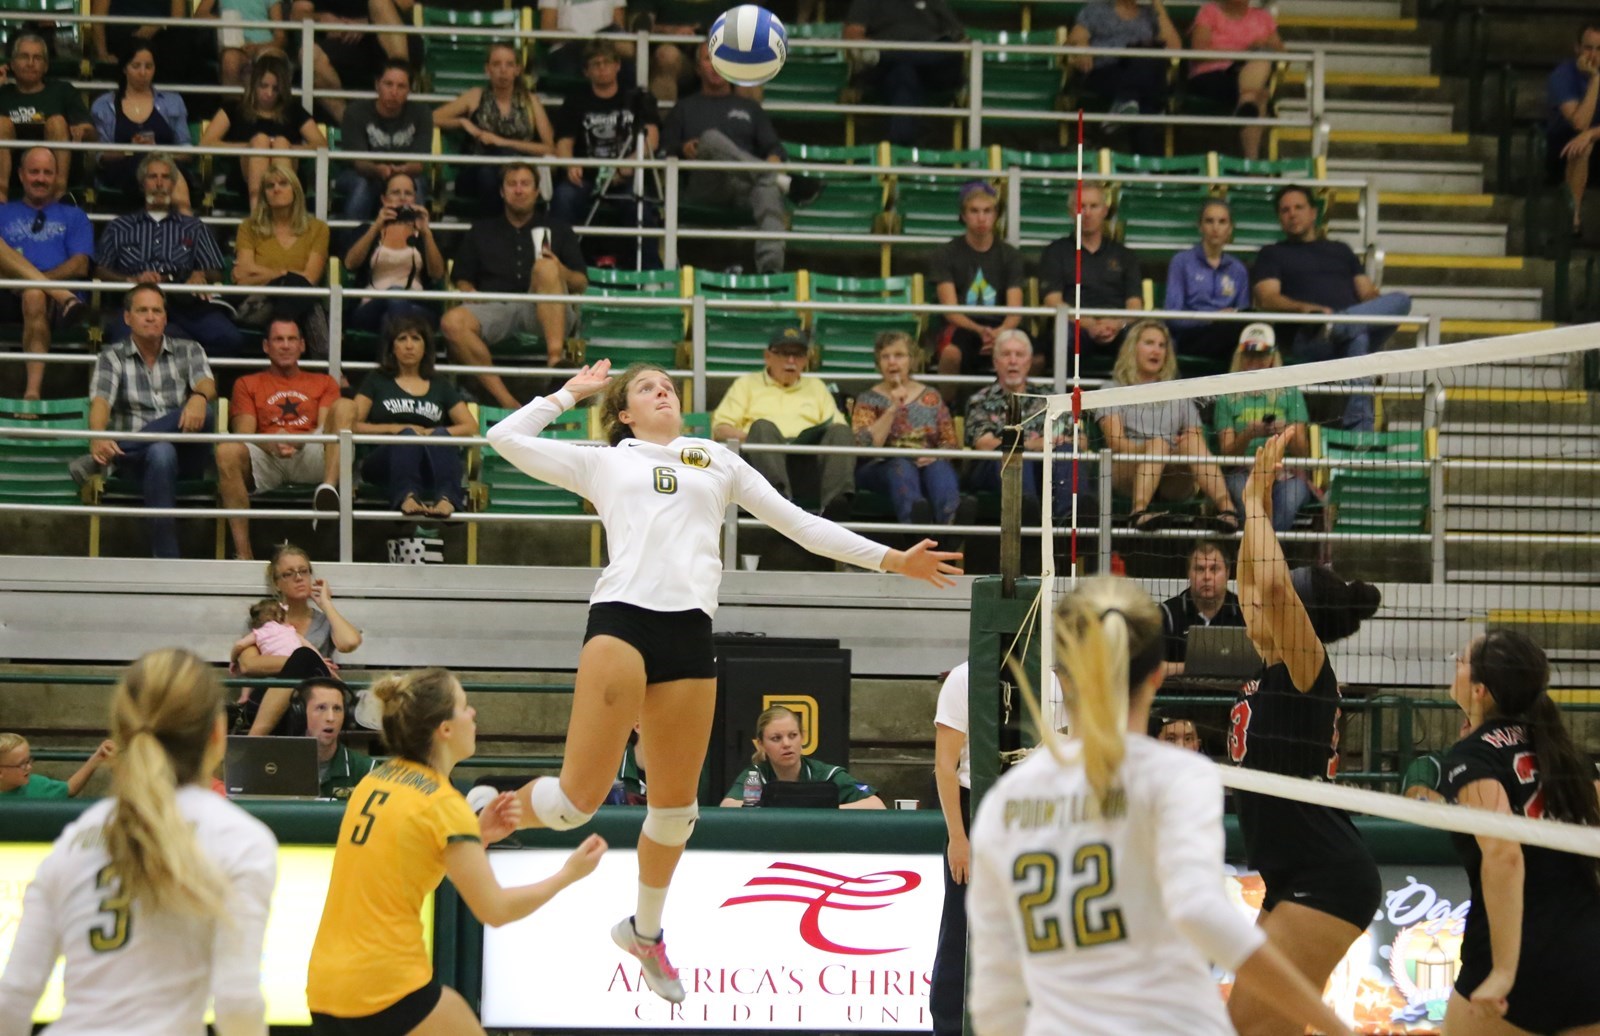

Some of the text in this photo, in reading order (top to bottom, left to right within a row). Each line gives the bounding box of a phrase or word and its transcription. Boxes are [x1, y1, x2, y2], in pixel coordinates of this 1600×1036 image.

[653, 466, 678, 495] 6
[1227, 700, 1252, 762] 3
[351, 789, 390, 846] 5
[90, 860, 132, 953] 3
[1013, 842, 1127, 953] 22
